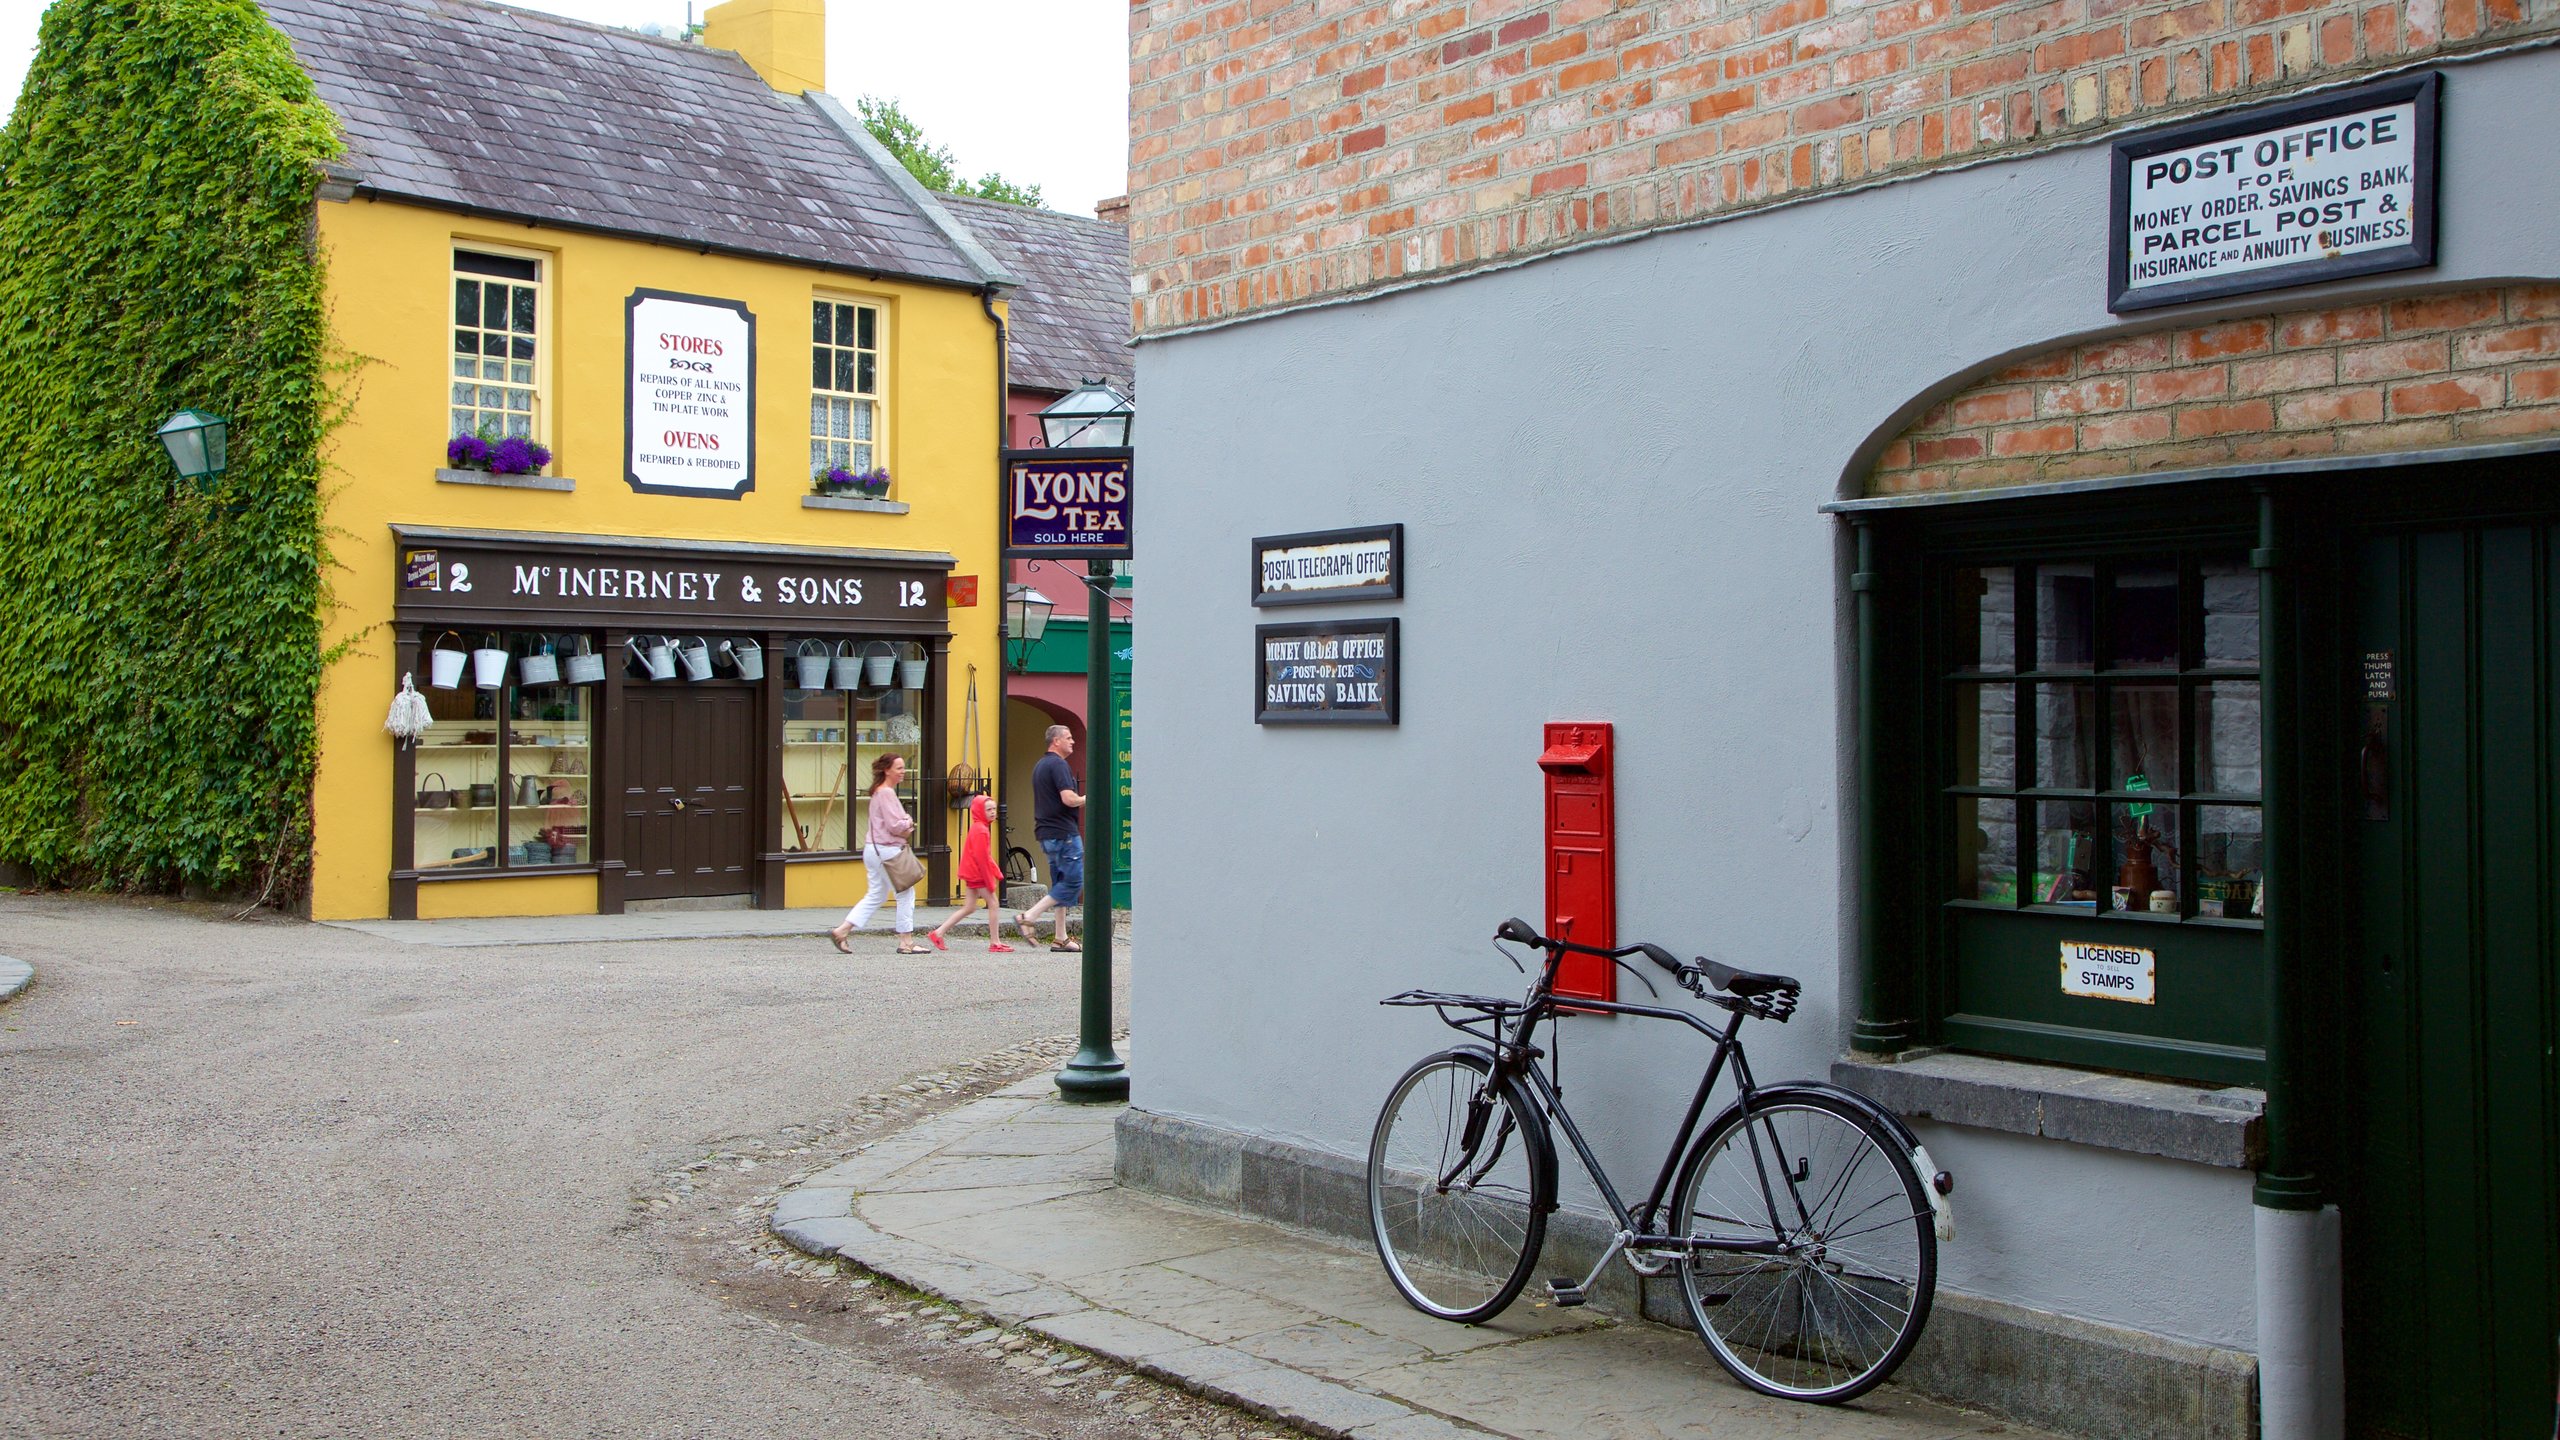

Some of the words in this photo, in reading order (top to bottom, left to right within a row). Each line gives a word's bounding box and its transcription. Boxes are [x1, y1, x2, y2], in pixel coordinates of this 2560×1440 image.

[2146, 146, 2243, 190] POST
[2254, 114, 2397, 168] OFFICE
[2238, 168, 2294, 191] FOR
[2133, 204, 2193, 232] MONEY
[2268, 174, 2349, 208] SAVINGS
[2144, 218, 2261, 255] PARCEL
[2276, 199, 2366, 232] POST
[2379, 193, 2398, 214] &
[2133, 251, 2217, 281] INSURANCE
[2220, 249, 2239, 262] AND
[2242, 233, 2312, 263] ANNUITY
[659, 332, 724, 357] STORES
[640, 373, 679, 387] REPAIRS
[680, 377, 692, 387] OF
[695, 379, 711, 390] ALL
[714, 380, 741, 393] KINDS
[655, 388, 693, 402] COPPER
[697, 392, 718, 404] ZINC
[720, 394, 727, 405] &
[653, 402, 668, 412] TIN
[671, 404, 699, 415] PLATE
[701, 406, 729, 418] WORK
[663, 429, 720, 451] OVENS
[640, 453, 685, 467] REPAIRED
[687, 457, 693, 467] &
[696, 457, 741, 470] REBODIED
[1063, 506, 1125, 531] TEA
[1034, 533, 1066, 543] SOLD
[1071, 532, 1104, 543] HERE
[431, 561, 472, 592] 12
[1263, 559, 1297, 582] POSTAL
[1298, 552, 1353, 579] TELEGRAPH
[741, 575, 762, 602] &
[777, 577, 863, 605] SONS
[900, 580, 926, 607] 12
[1266, 641, 1301, 661] MONEY
[1303, 640, 1339, 660] ORDER
[1342, 639, 1384, 659] OFFICE
[2363, 662, 2392, 670] THUMB
[1267, 683, 1326, 703] SAVINGS
[2368, 690, 2389, 698] PUSH
[2369, 681, 2387, 689] AND
[2076, 946, 2141, 965] LICENSED
[2081, 971, 2134, 990] STAMPS
